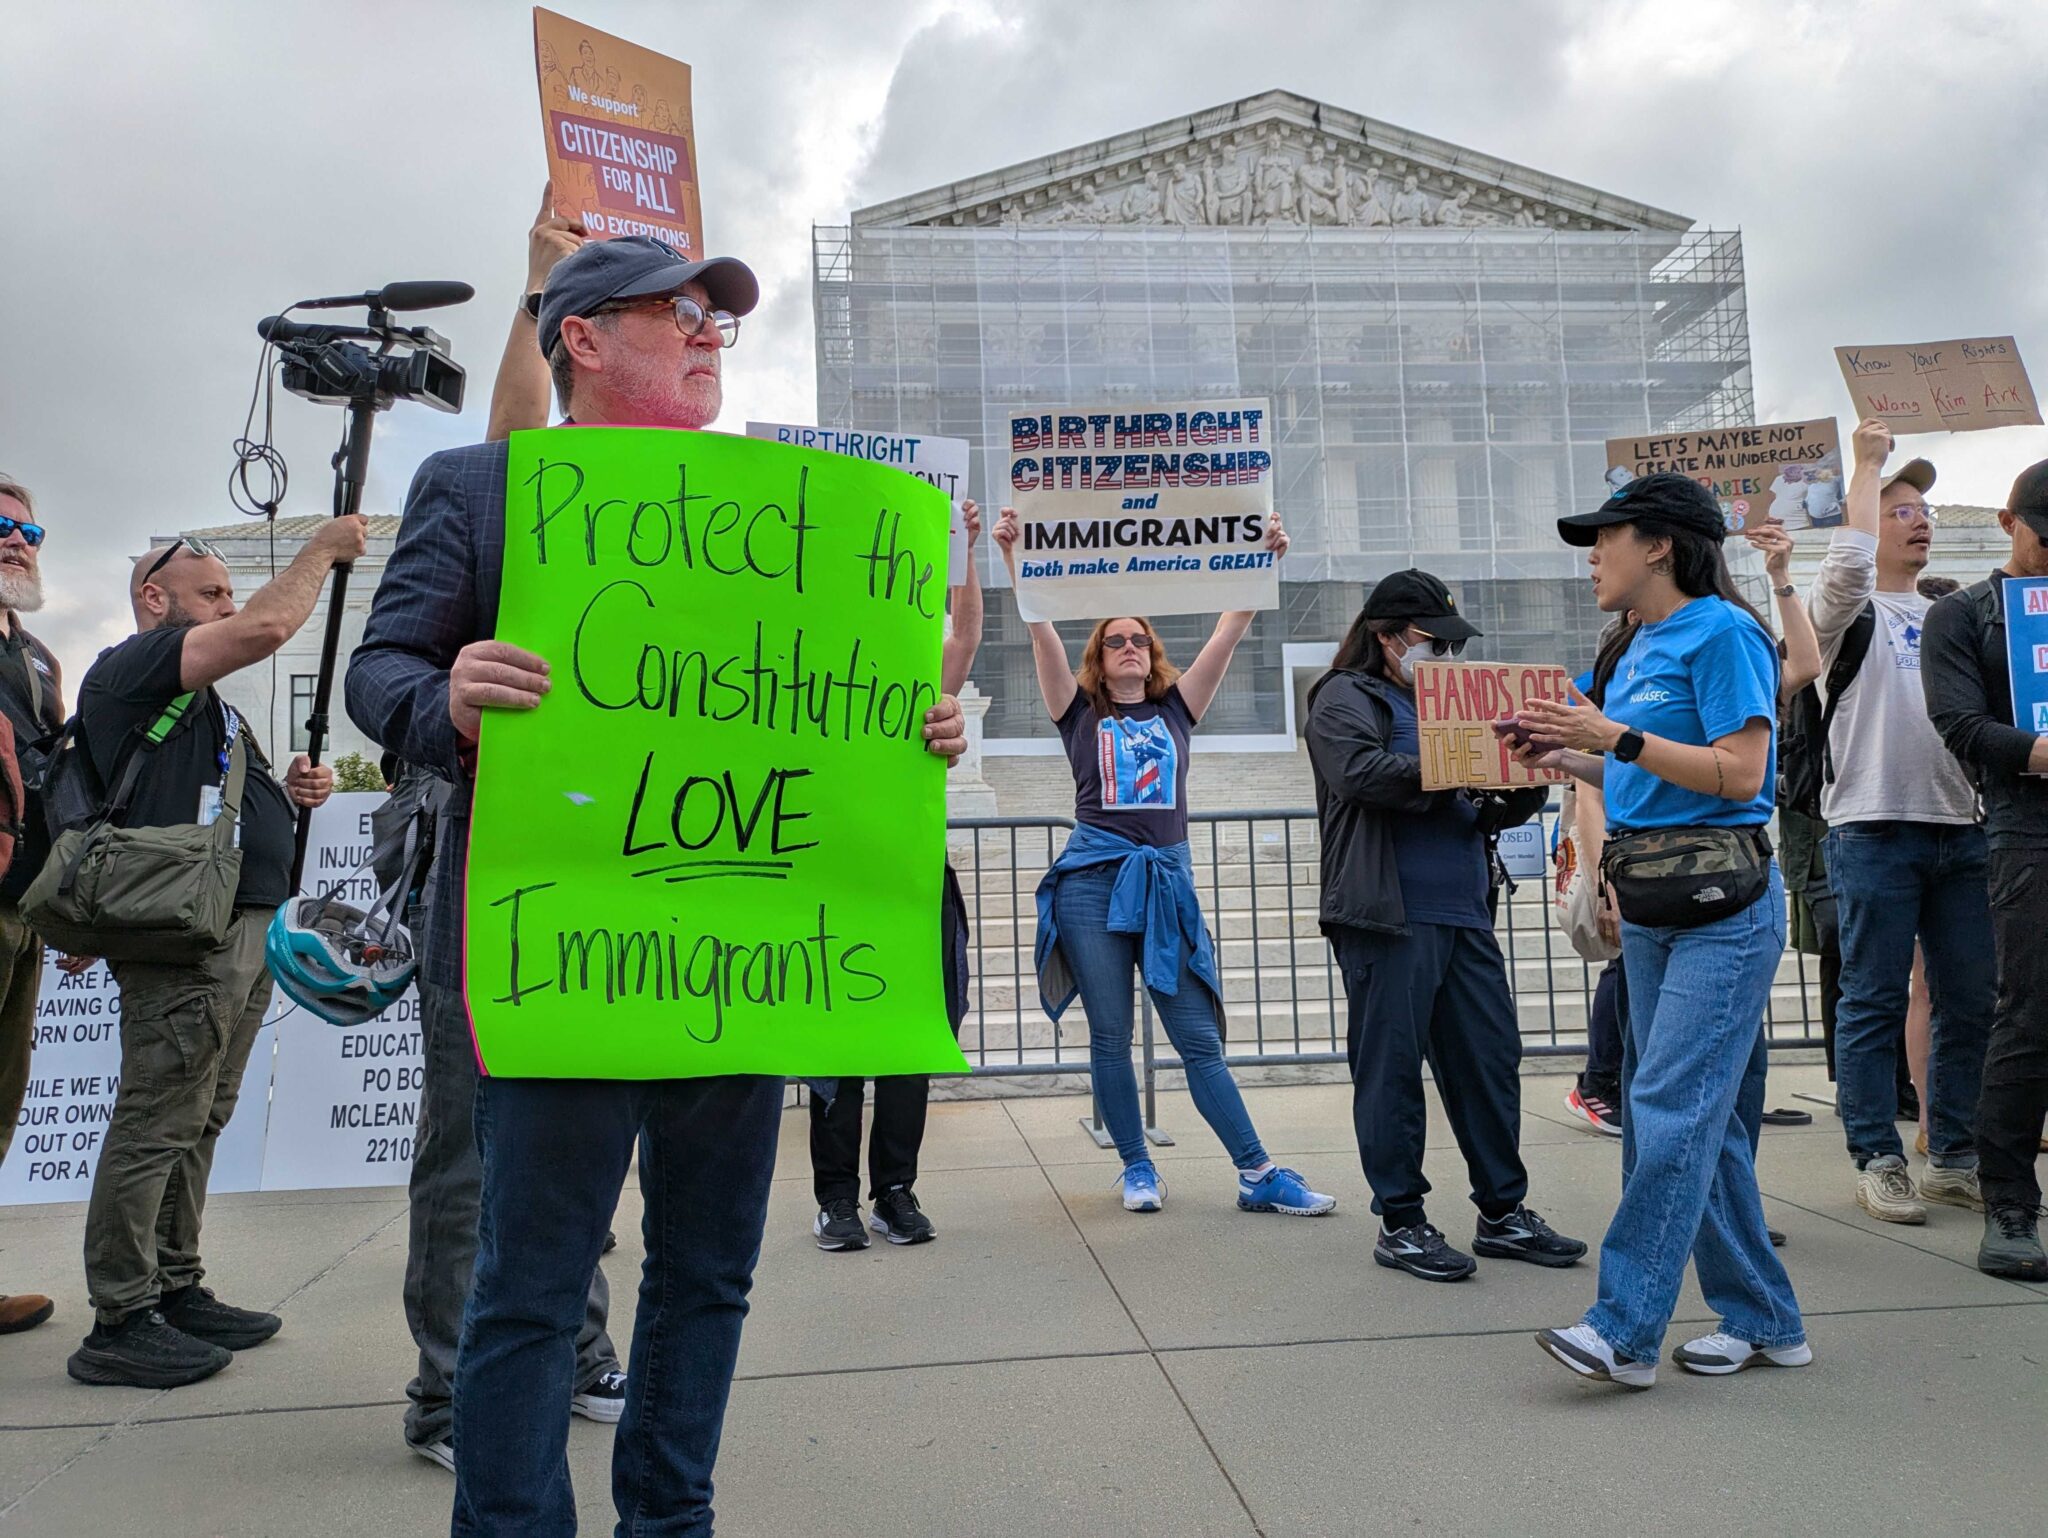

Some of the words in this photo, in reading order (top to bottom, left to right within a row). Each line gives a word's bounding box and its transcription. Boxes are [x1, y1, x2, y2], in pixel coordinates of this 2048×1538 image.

[568, 85, 588, 104] We
[591, 96, 639, 118] support
[561, 121, 677, 175] CITIZENSHIP
[602, 166, 634, 194] FOR
[635, 172, 676, 215] ALL
[582, 211, 605, 232] NO
[608, 216, 690, 250] EXCEPTIONS!
[1846, 350, 1892, 374] Know
[1906, 351, 1942, 374] Your
[1961, 343, 2007, 359] Rights
[1867, 393, 1920, 414] Wong
[1930, 387, 1967, 413] Kim
[778, 427, 921, 463] BIRTHRIGHT
[1011, 410, 1263, 452] BIRTHRIGHT
[1634, 437, 1689, 460] LET'S
[1697, 430, 1763, 453] MAYBE
[1768, 426, 1806, 443] NOT
[1011, 450, 1272, 491] CITIZENSHIP
[1635, 457, 1699, 478] CREATE
[1704, 454, 1726, 470] AN
[1730, 443, 1825, 468] UNDERCLASS
[1121, 493, 1159, 510] and
[522, 457, 820, 594] Protect
[854, 507, 936, 620] the
[1023, 514, 1263, 550] IMMIGRANTS
[1021, 560, 1063, 578] both
[1068, 558, 1119, 575] make
[1126, 554, 1202, 573] America
[1208, 552, 1274, 571] GREAT!
[573, 580, 937, 752] Constitution
[1417, 667, 1514, 722] HANDS
[1520, 669, 1566, 714] OFF
[1422, 727, 1487, 784] THE
[622, 751, 821, 857] LOVE
[1498, 831, 1533, 843] OSED
[489, 881, 887, 1044] Immigrants
[57, 971, 98, 990] ARE
[73, 1022, 114, 1043] OUT
[70, 1077, 102, 1096] WE
[363, 1067, 391, 1093] PO
[17, 1106, 59, 1127] OUR
[24, 1133, 68, 1154] OUT
[72, 1131, 101, 1151] OF
[28, 1160, 71, 1182] FOR
[75, 1159, 90, 1179] A
